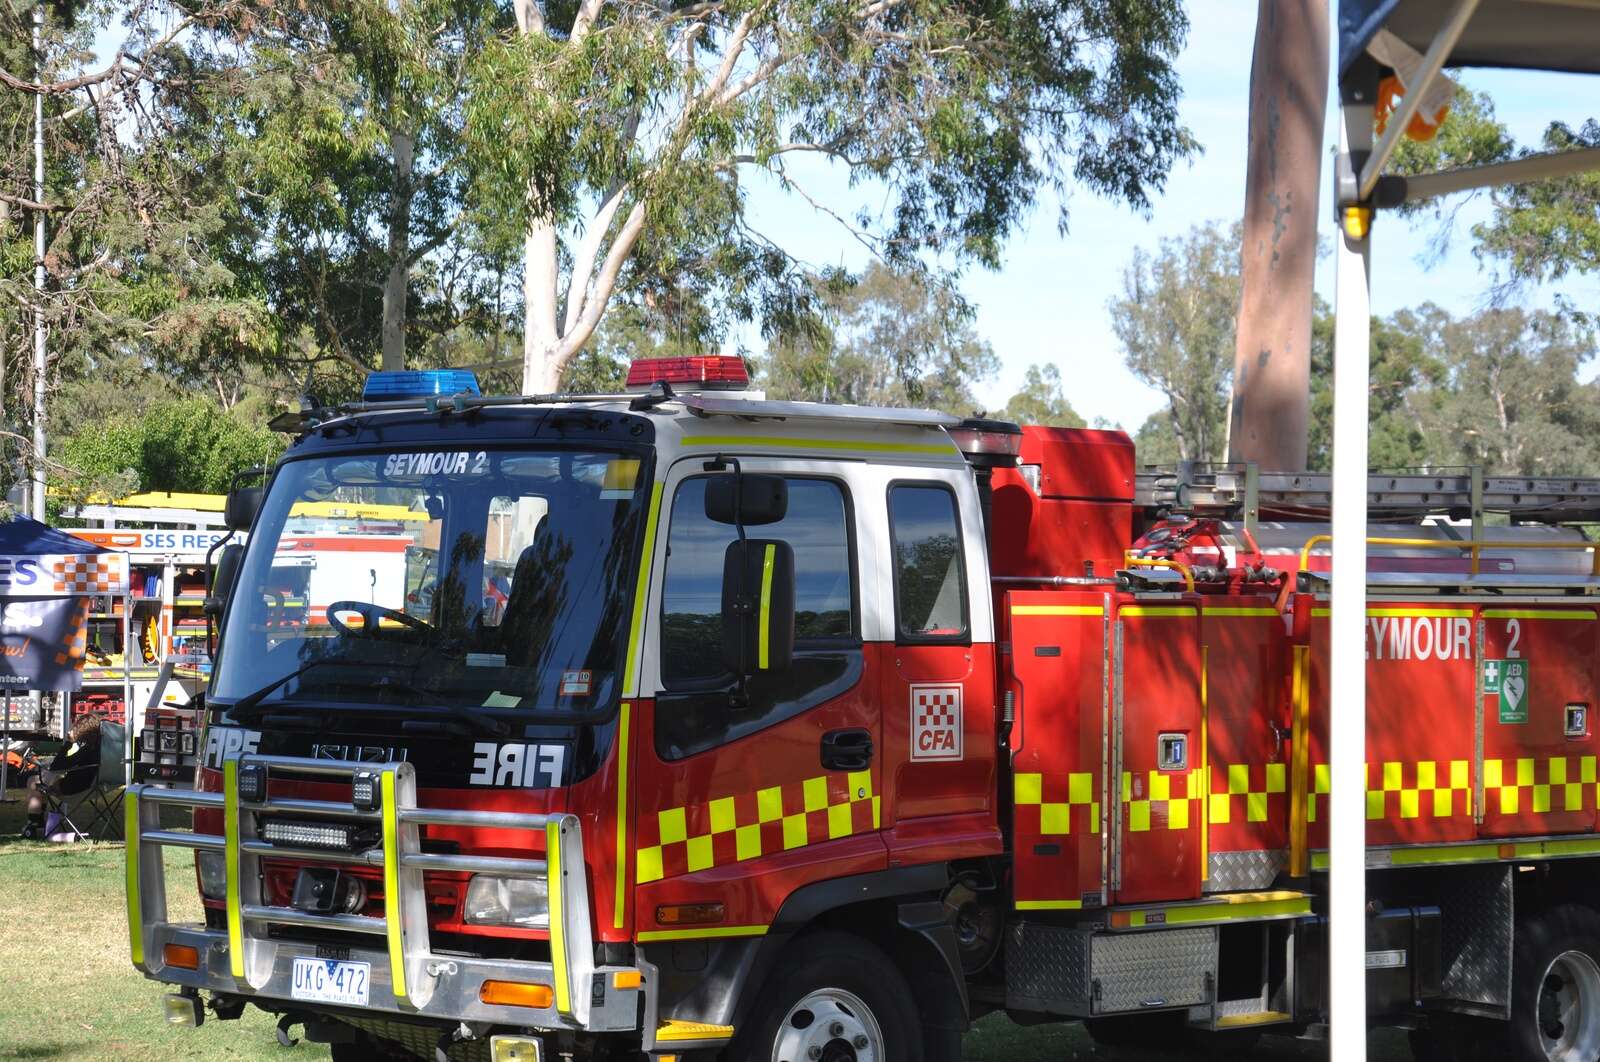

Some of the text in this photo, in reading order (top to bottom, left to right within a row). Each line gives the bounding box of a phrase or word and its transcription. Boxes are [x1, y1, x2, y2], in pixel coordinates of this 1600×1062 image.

[383, 451, 487, 476] SEYMOUR 2
[144, 534, 242, 548] SES RES
[1365, 616, 1521, 661] YMOUR 2
[1506, 664, 1523, 676] AED
[1576, 711, 1583, 728] 2
[918, 729, 955, 751] CFA
[1175, 743, 1181, 760] 1
[295, 963, 366, 995] UKG 472
